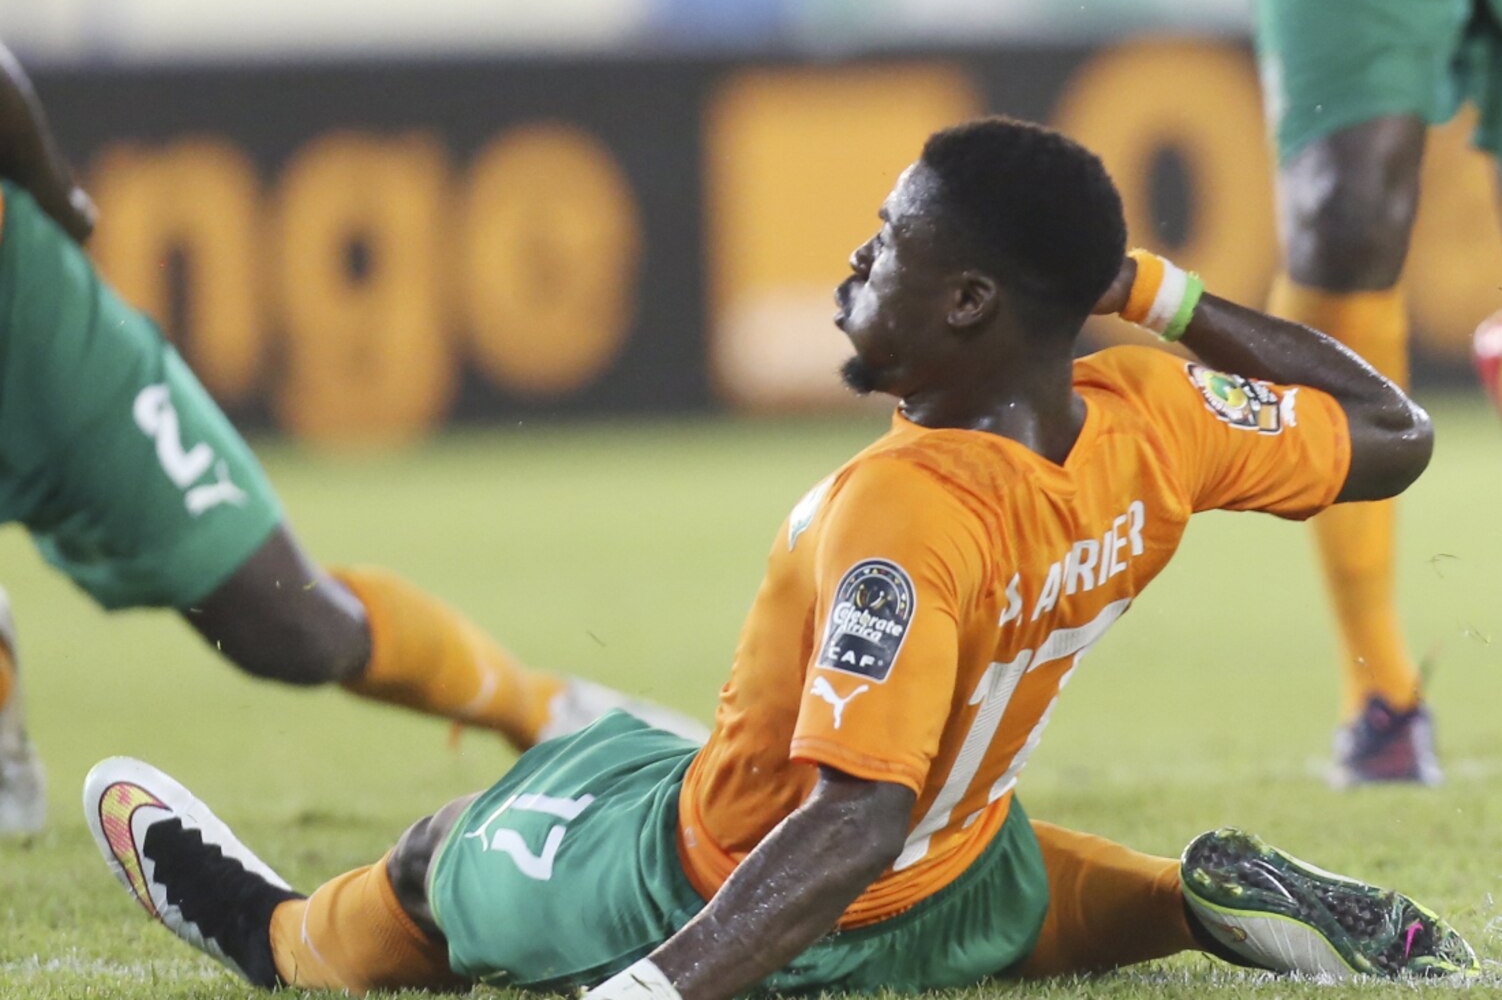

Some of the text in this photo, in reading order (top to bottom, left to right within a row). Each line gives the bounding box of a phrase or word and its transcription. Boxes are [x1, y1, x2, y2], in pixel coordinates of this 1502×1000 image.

[833, 601, 903, 637] Celebrate
[893, 596, 1134, 872] 17
[490, 792, 596, 882] 17
